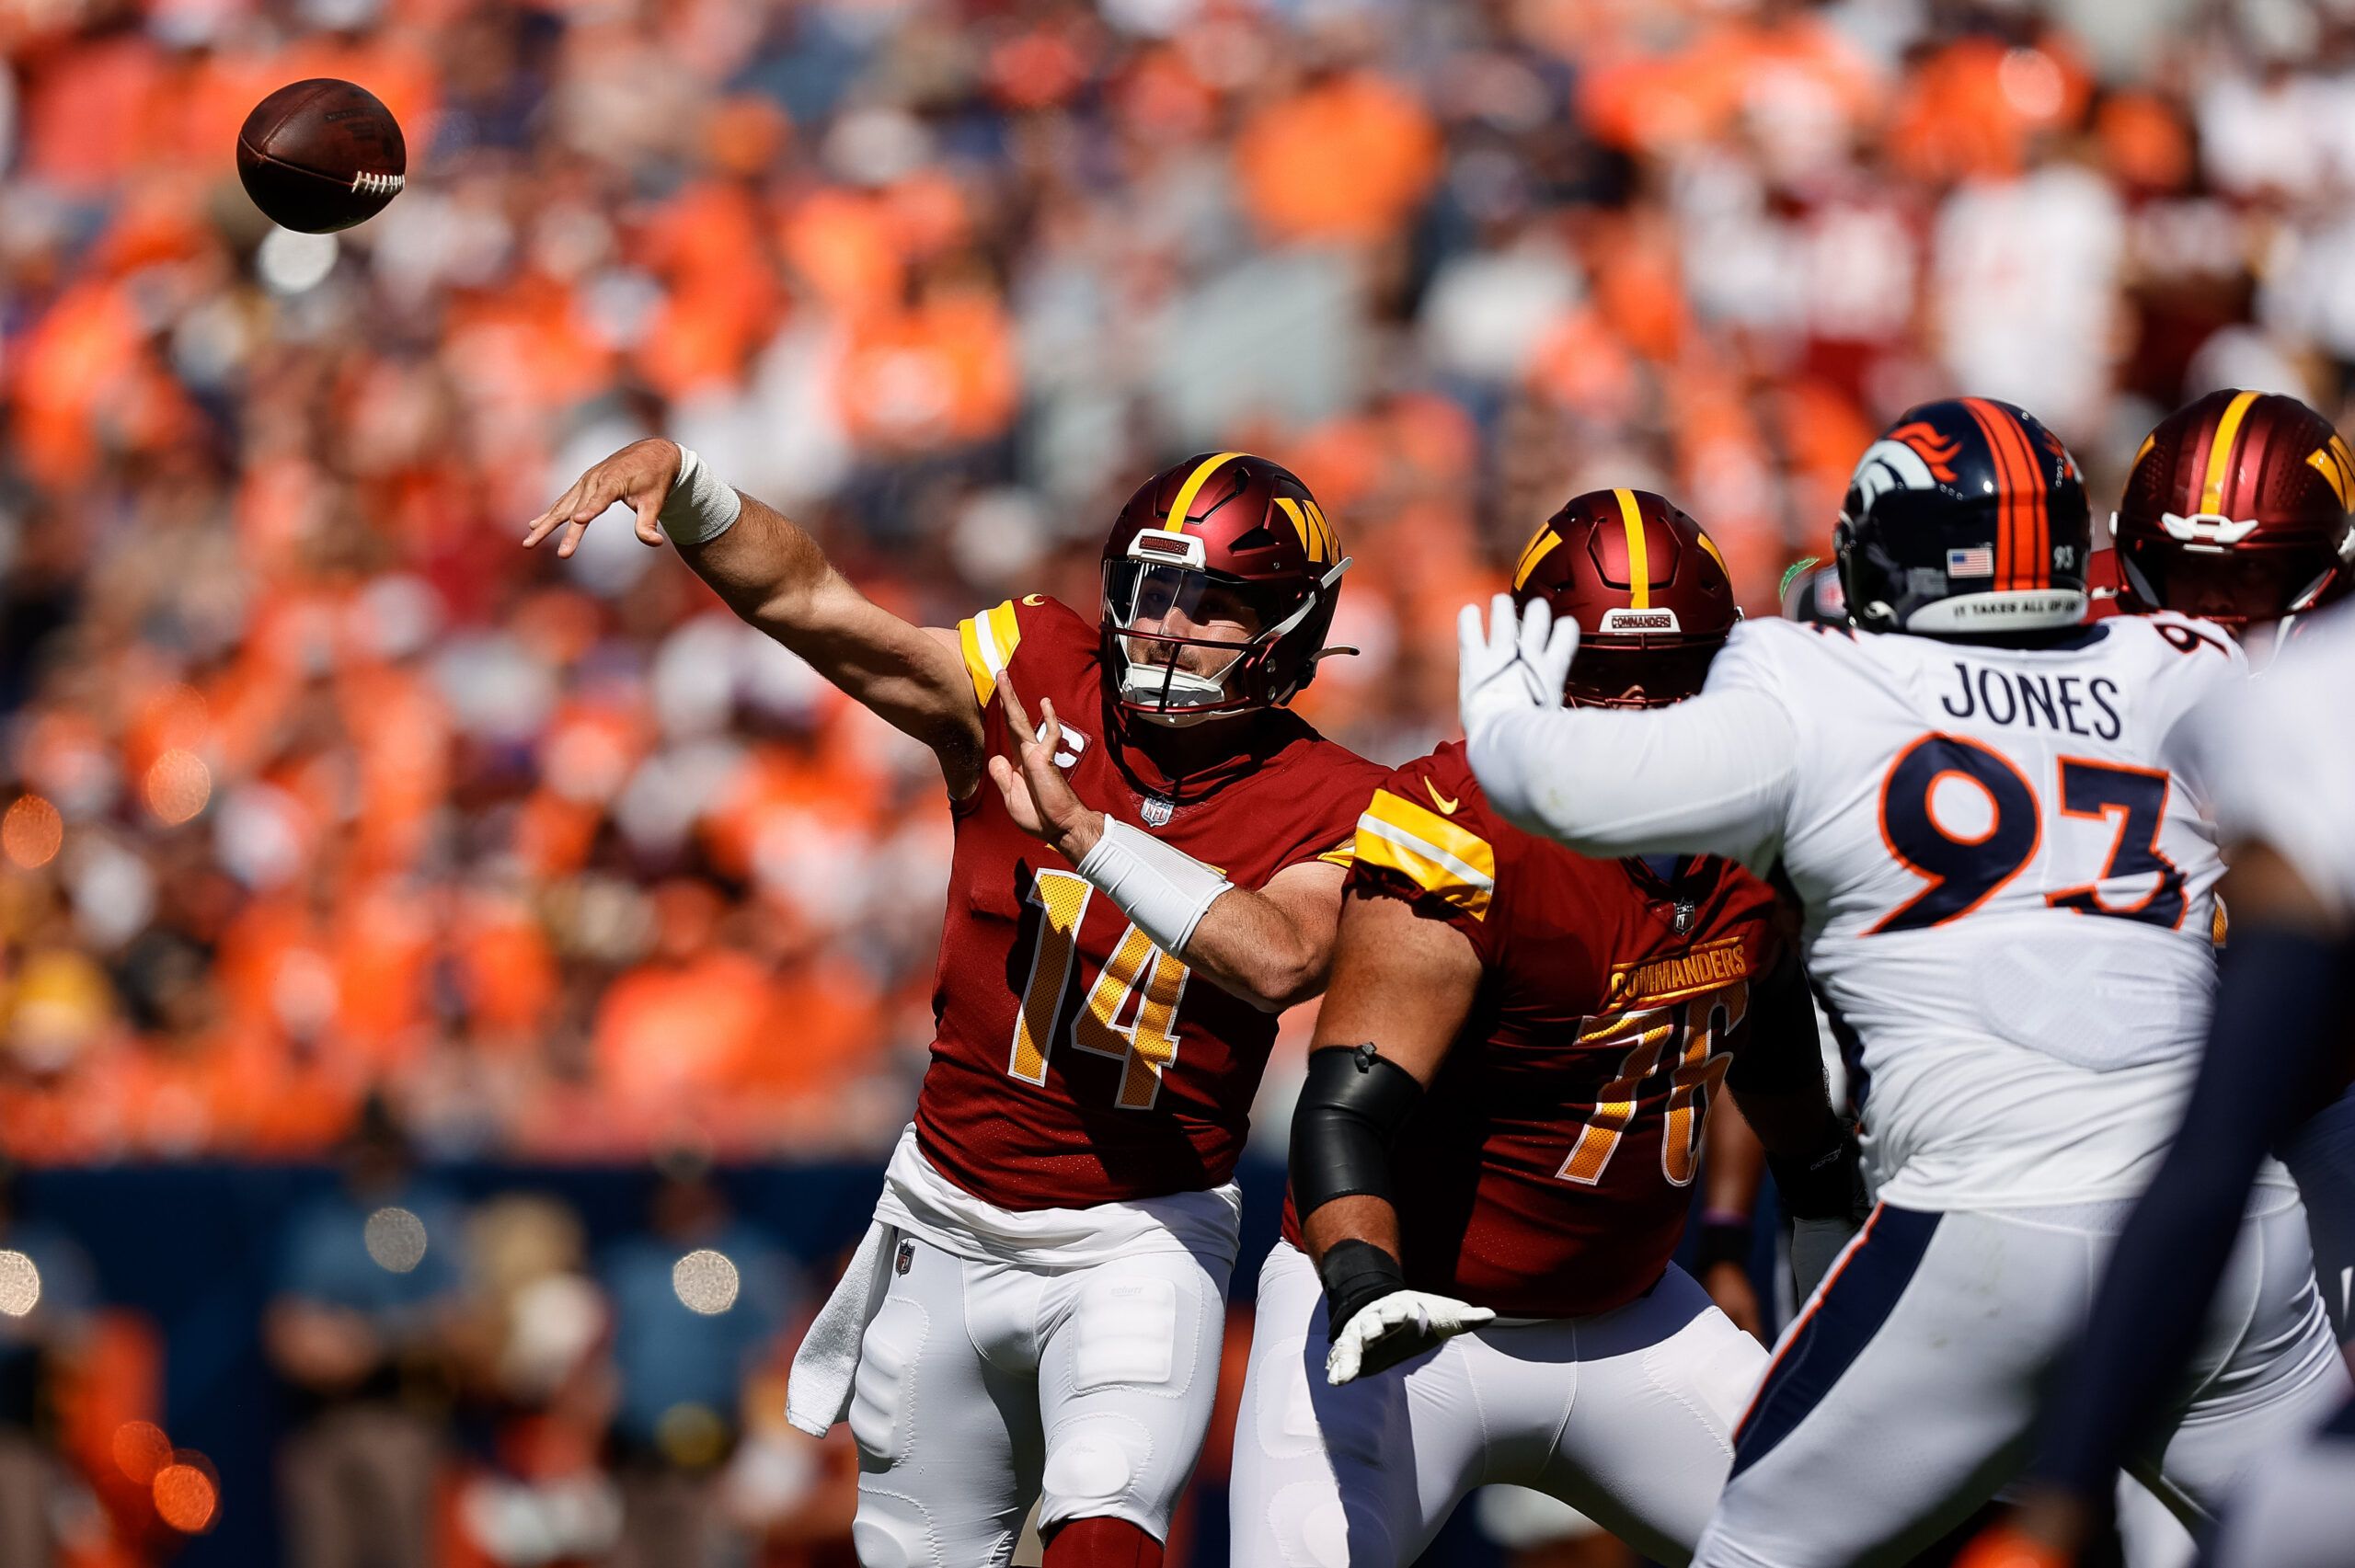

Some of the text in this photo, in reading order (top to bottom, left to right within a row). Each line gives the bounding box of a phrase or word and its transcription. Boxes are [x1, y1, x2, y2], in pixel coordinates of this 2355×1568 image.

[2053, 545, 2074, 569] 93
[1612, 615, 1671, 628] COMMANDERS
[1941, 662, 2122, 740] JONES
[1856, 731, 2190, 938] 93
[1007, 867, 1191, 1110] 14
[1611, 943, 1747, 1001] COMMANDERS
[1555, 979, 1750, 1187] 76
